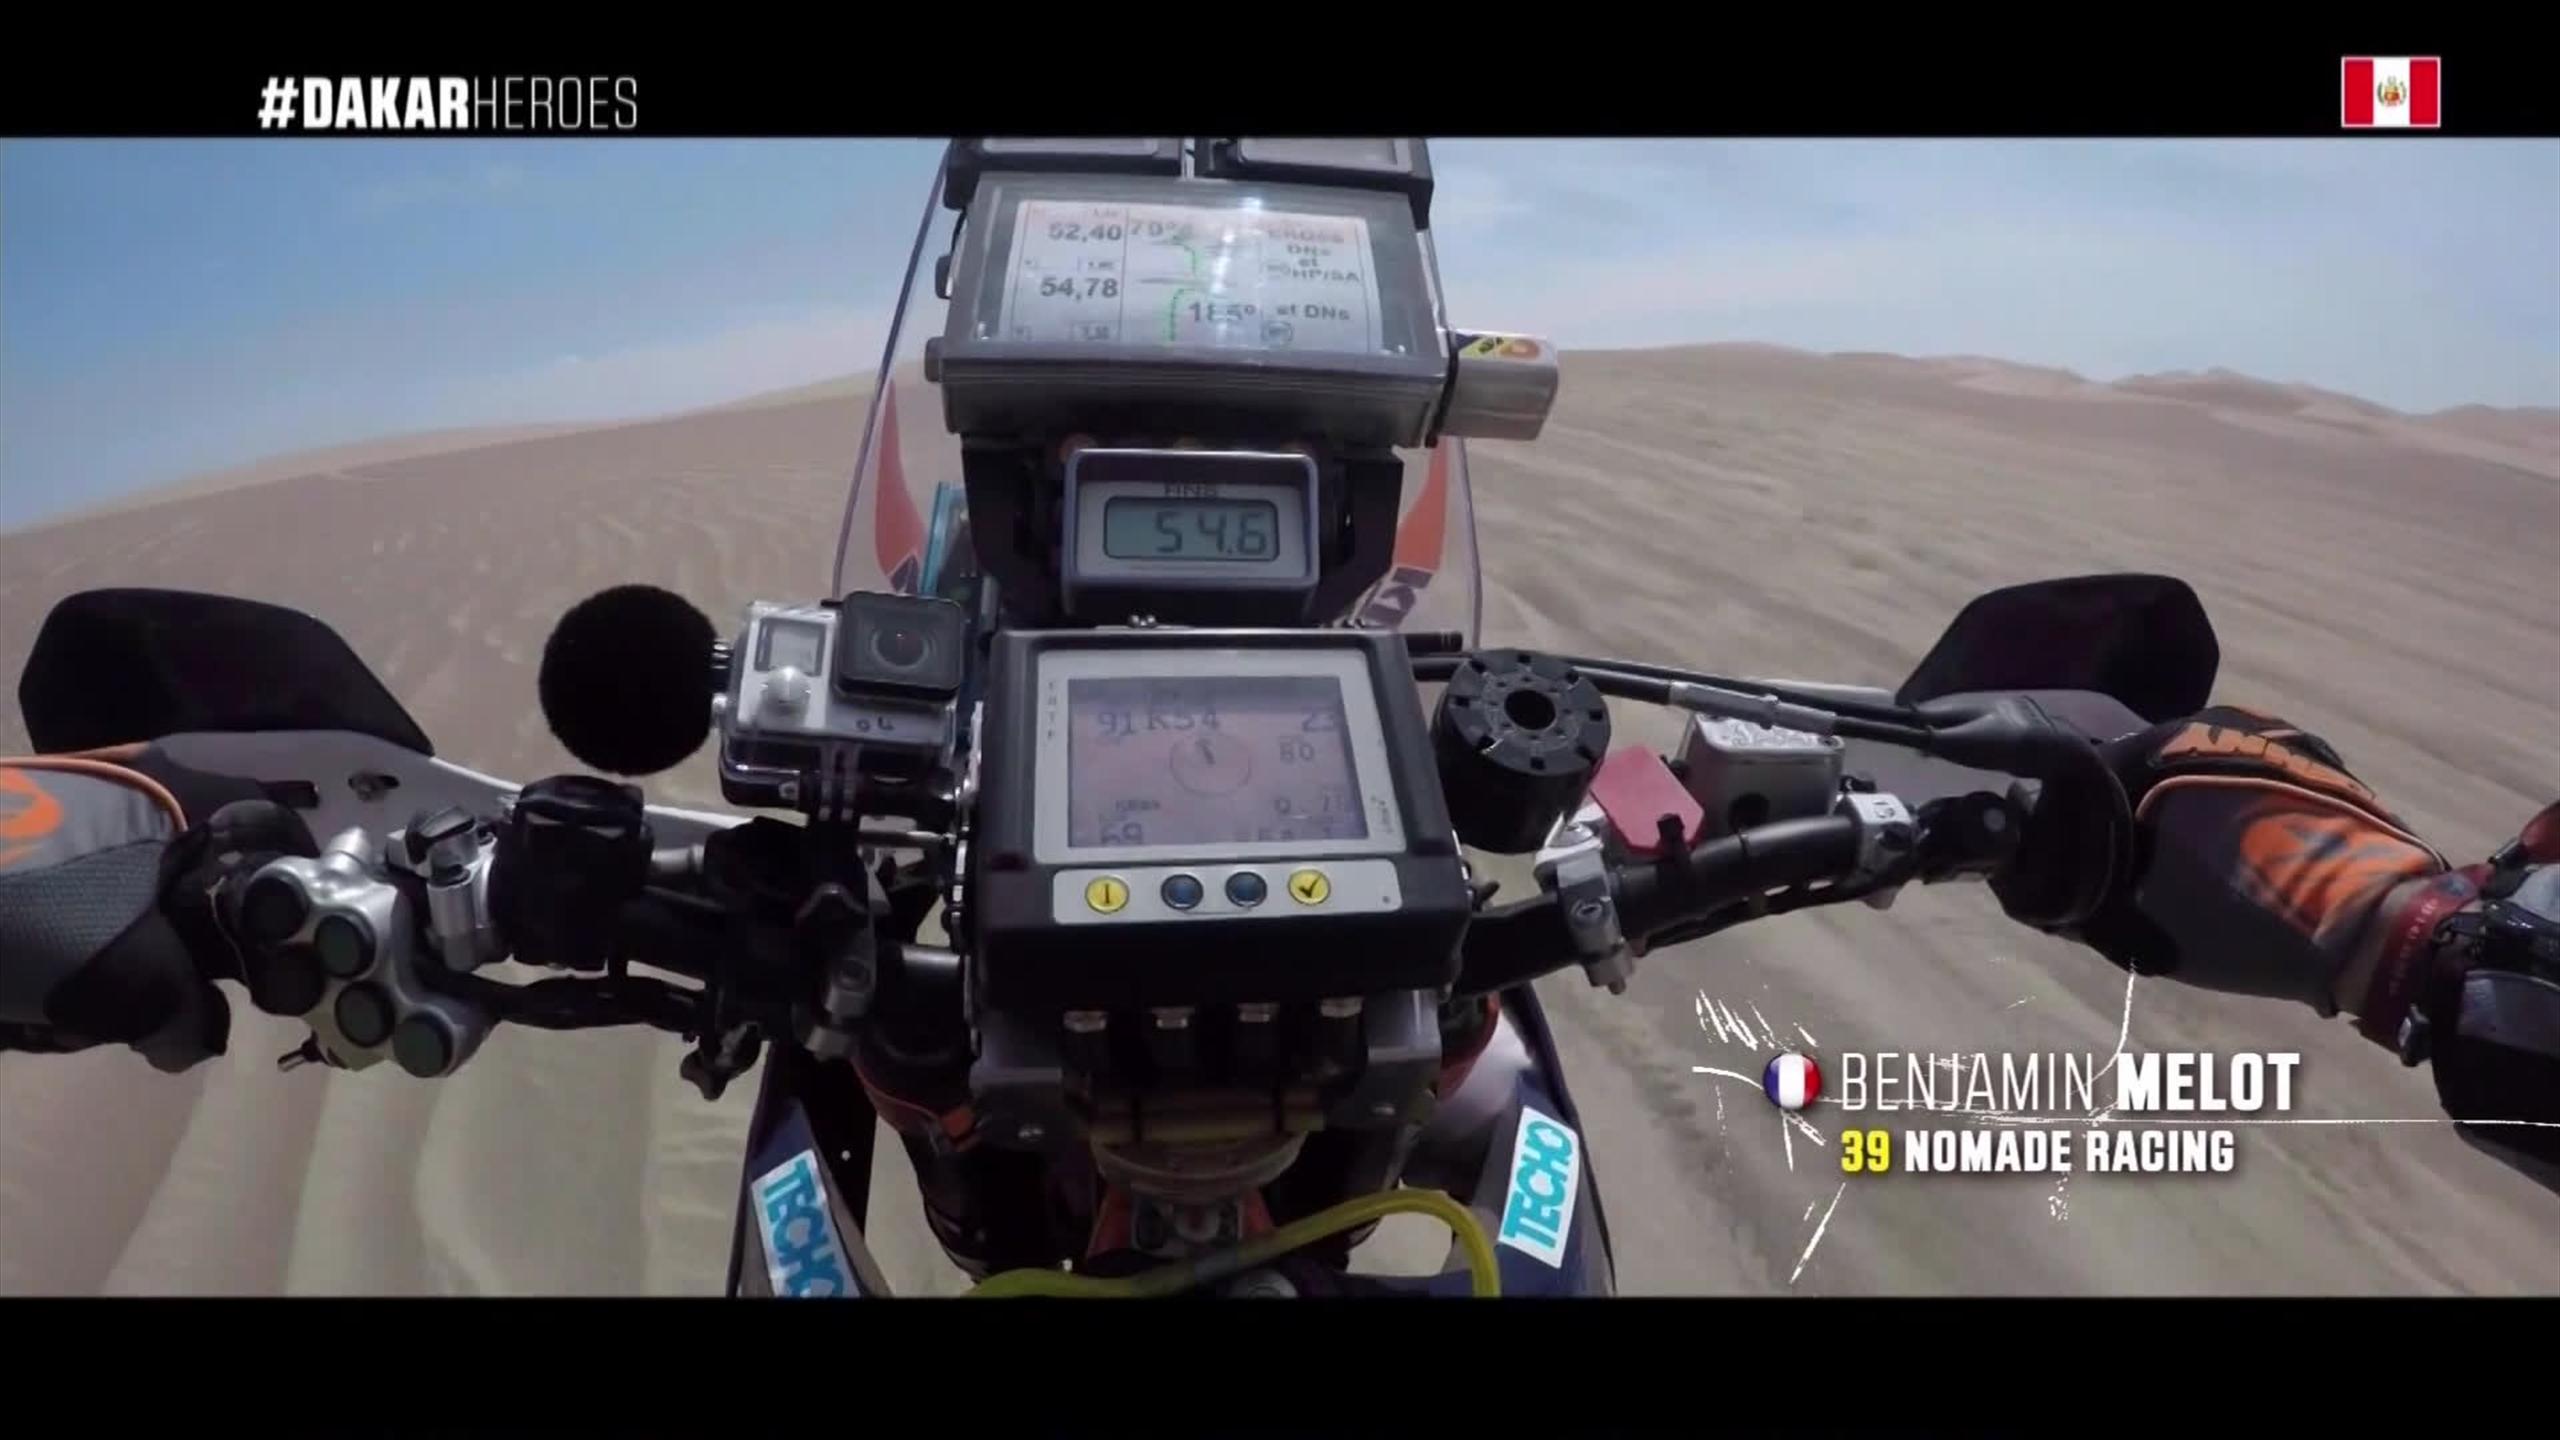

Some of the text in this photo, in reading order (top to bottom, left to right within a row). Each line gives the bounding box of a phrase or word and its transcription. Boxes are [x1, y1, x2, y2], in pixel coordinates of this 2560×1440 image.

[1049, 222, 1122, 243] 52,40
[1041, 277, 1118, 303] 54,78
[1503, 1120, 1573, 1249] TECHO
